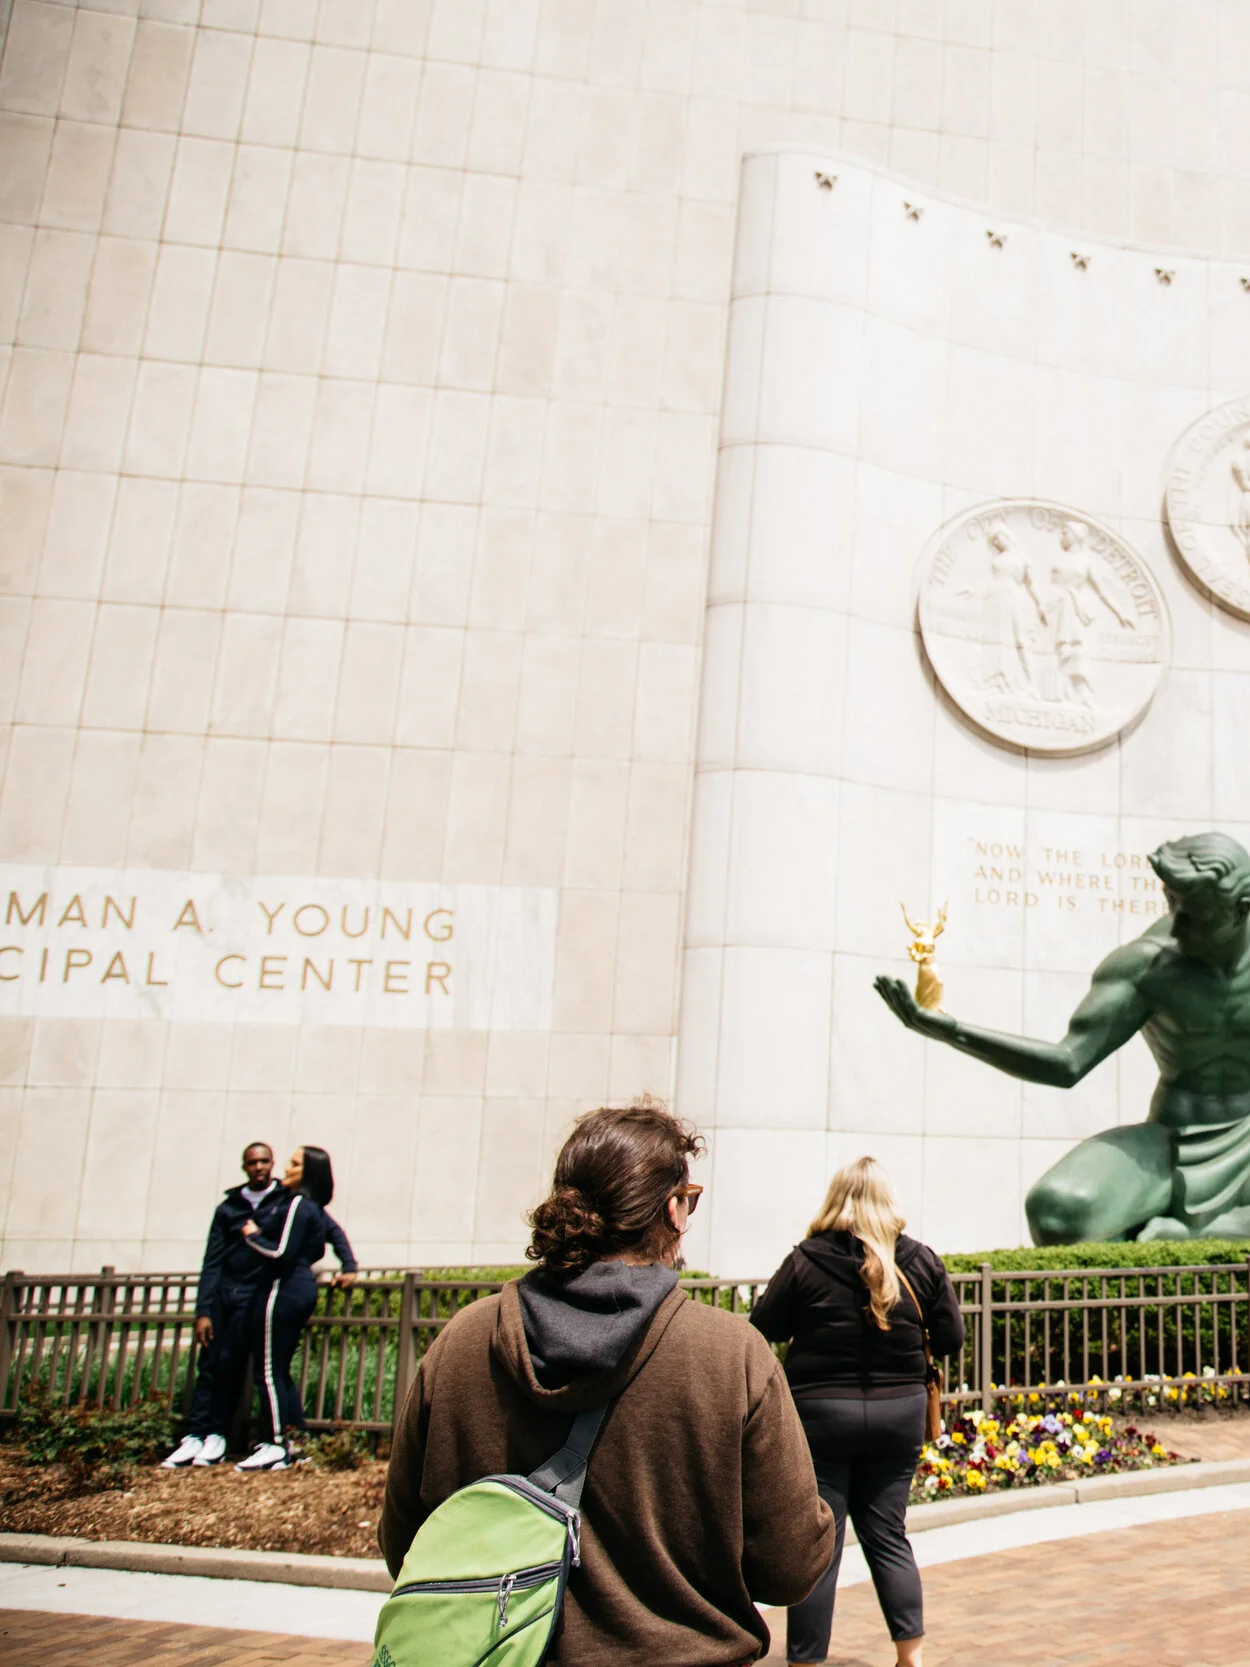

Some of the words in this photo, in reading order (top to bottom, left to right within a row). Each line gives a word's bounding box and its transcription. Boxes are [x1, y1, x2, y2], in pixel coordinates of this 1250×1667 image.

[1090, 531, 1160, 621] DETROIT
[984, 701, 1096, 734] MICHIGAN
[1044, 848, 1083, 865] THE
[974, 865, 1022, 883] AND
[1038, 871, 1114, 890] WHERE
[1130, 877, 1165, 892] TH
[5, 890, 137, 930] MAN
[172, 898, 214, 933] A.
[258, 900, 455, 942] YOUNG
[974, 888, 1039, 908] LORD
[1058, 895, 1077, 911] IS
[0, 944, 169, 987] CIPAL
[214, 953, 452, 995] CENTER
